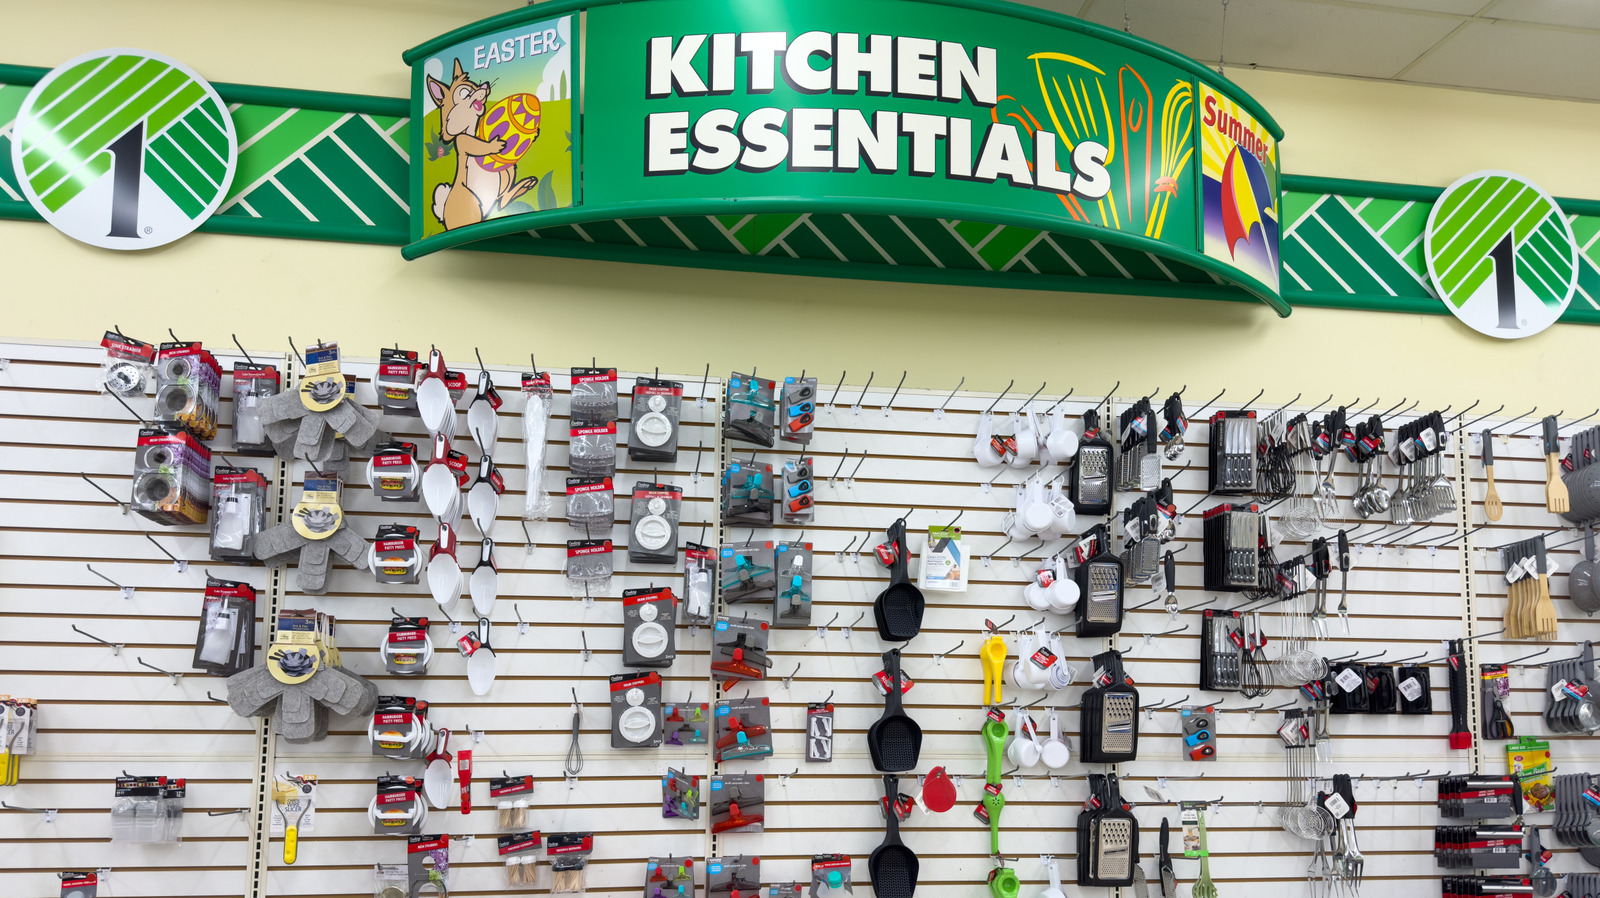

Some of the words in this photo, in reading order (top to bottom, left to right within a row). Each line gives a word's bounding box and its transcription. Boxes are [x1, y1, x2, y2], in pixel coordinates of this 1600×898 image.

[474, 28, 560, 70] EASTER
[647, 31, 997, 106] KITCHEN
[1203, 95, 1268, 166] Summer
[645, 107, 1111, 200] ESSENTIALS
[447, 381, 462, 389] SCOOP
[448, 460, 463, 468] SCOOP
[879, 548, 889, 560] SCOOP
